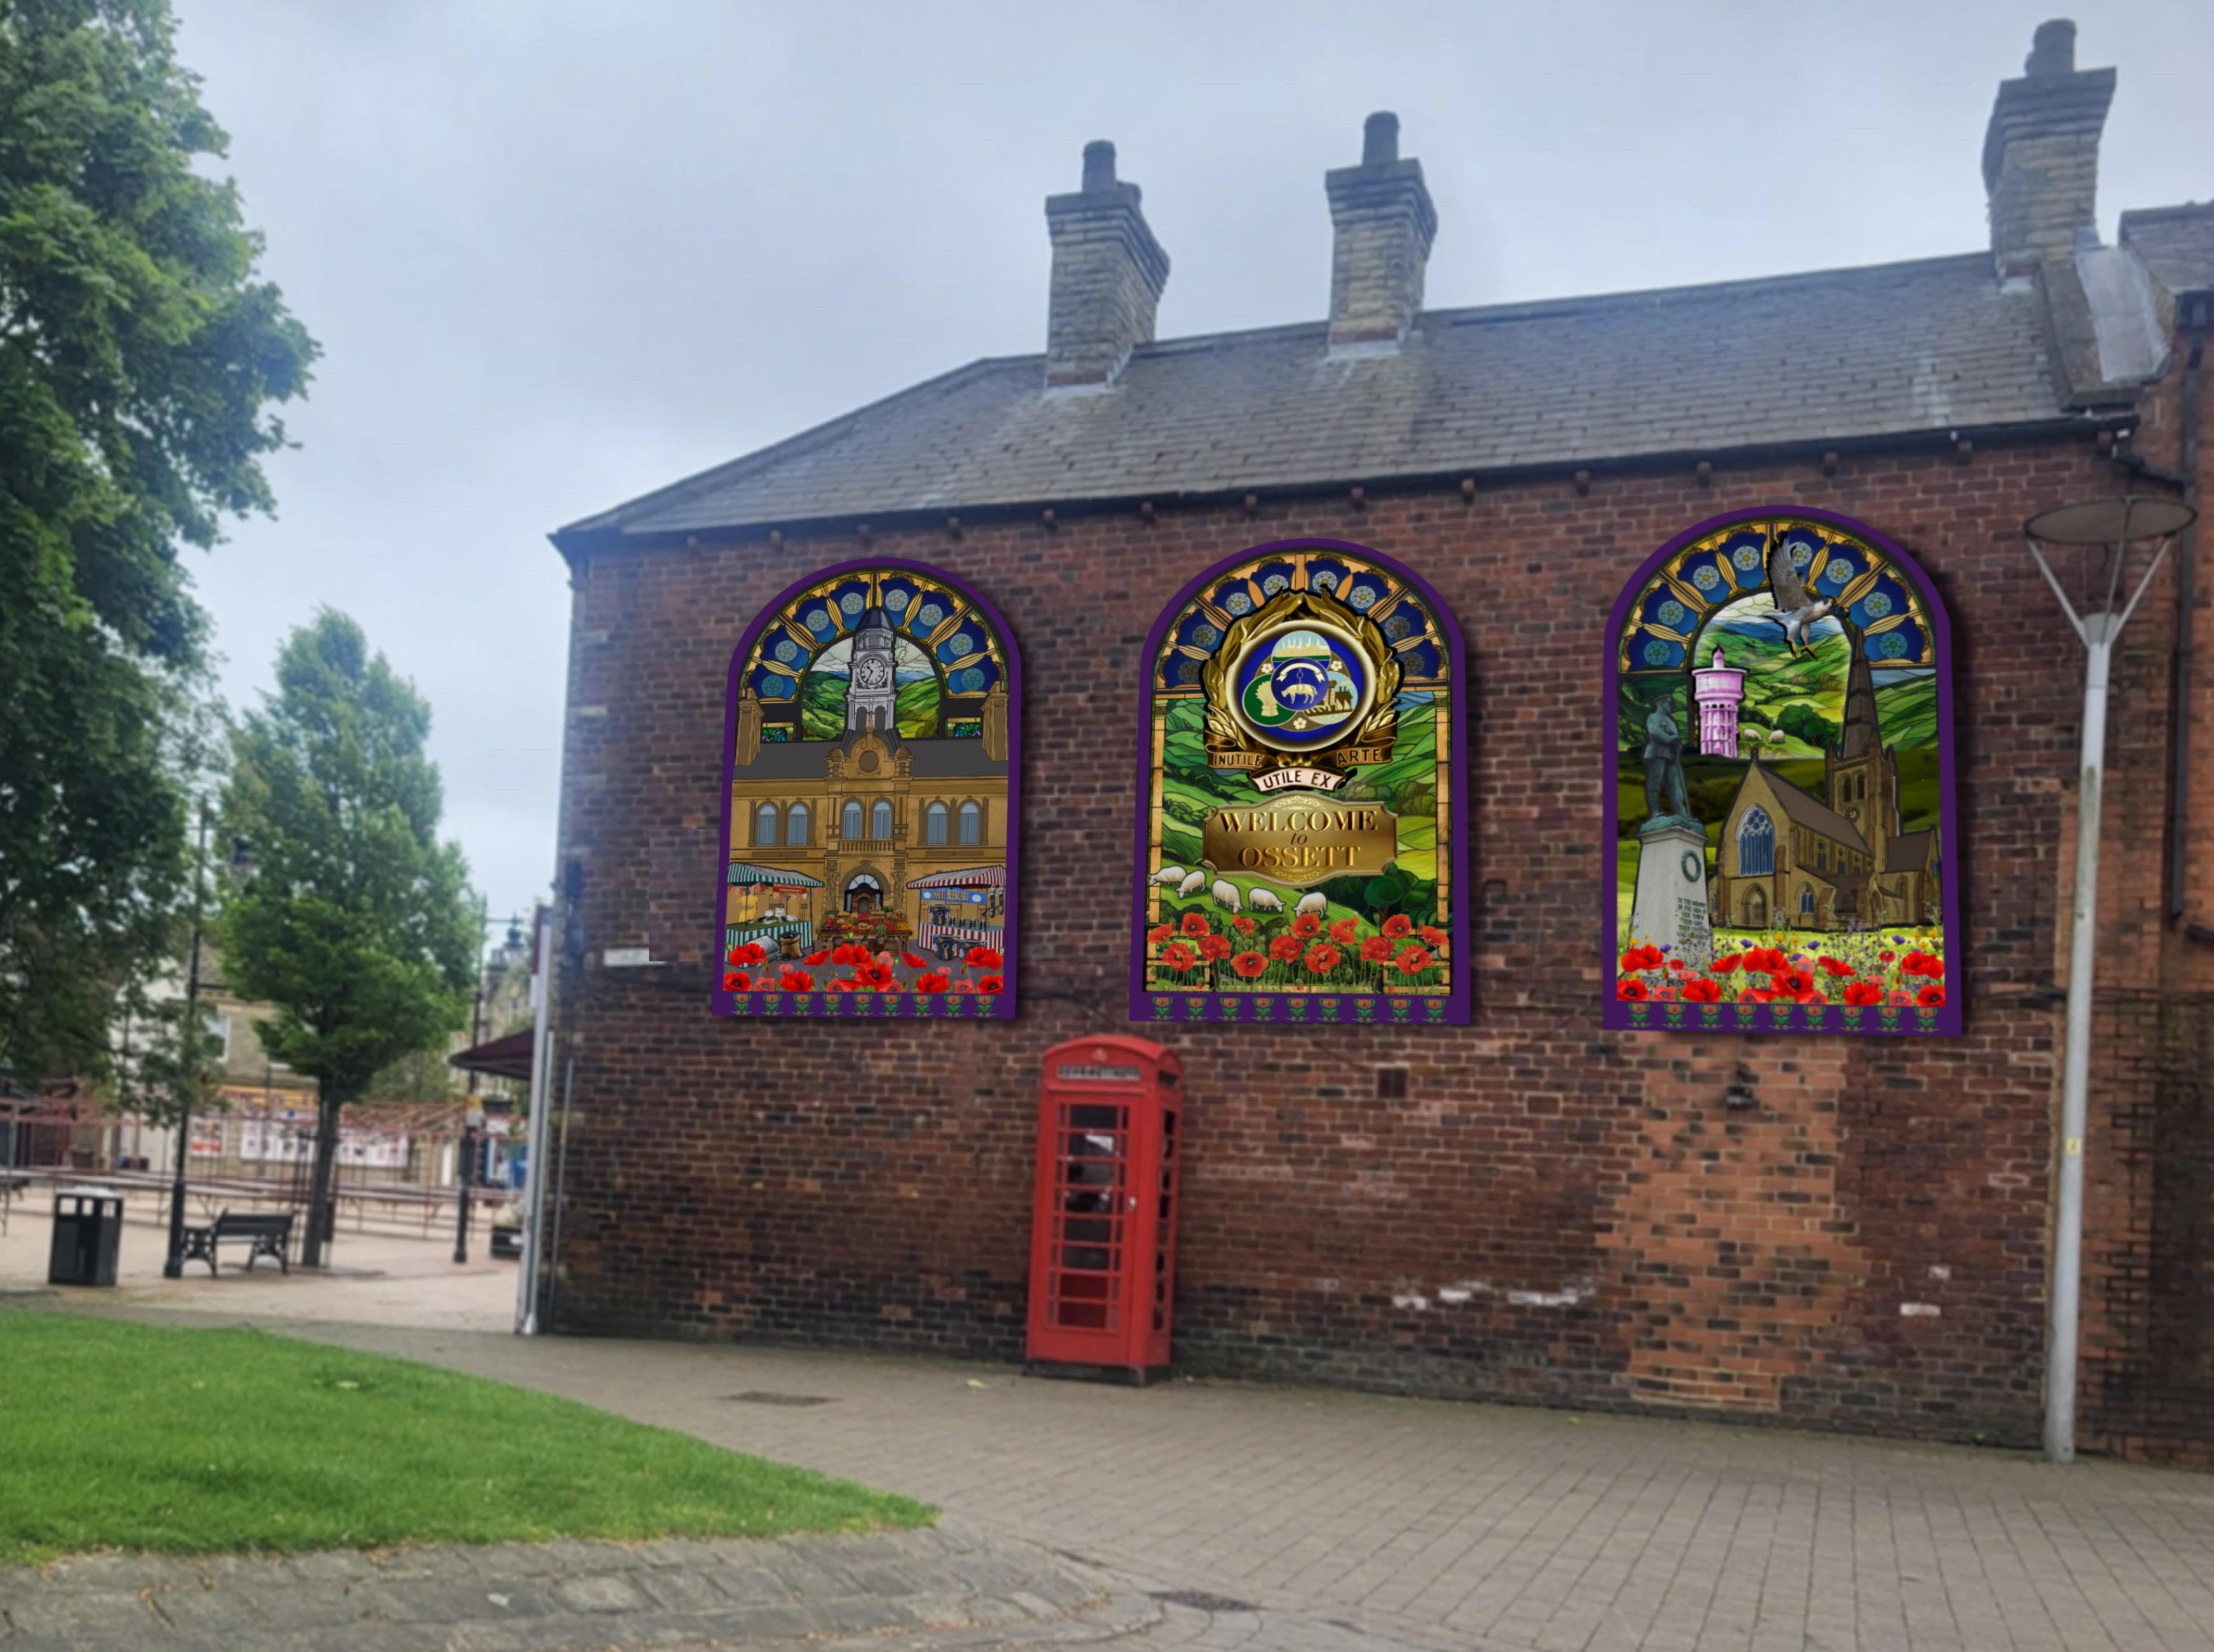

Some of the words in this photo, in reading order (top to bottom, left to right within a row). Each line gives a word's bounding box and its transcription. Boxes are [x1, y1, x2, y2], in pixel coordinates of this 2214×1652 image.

[1214, 754, 1264, 767] INUTILE
[1337, 749, 1382, 767] ARTE
[1263, 770, 1302, 789] UTILE
[1311, 772, 1333, 788] EX
[1220, 810, 1378, 832] WELCOME
[1290, 833, 1307, 845] to
[1240, 846, 1361, 867] OSSETT
